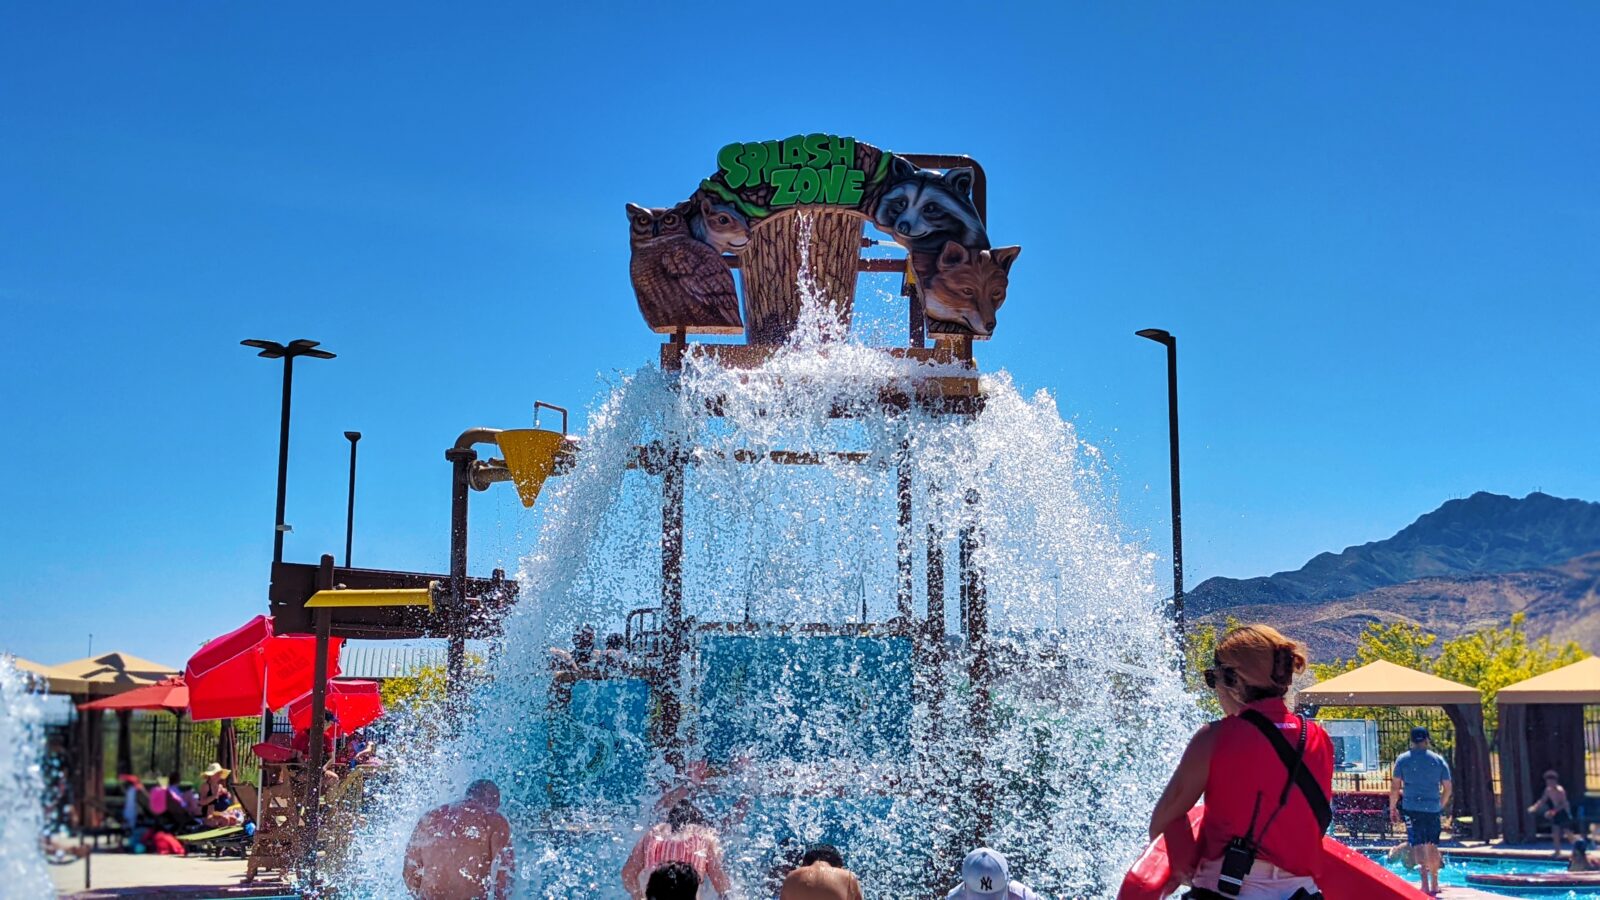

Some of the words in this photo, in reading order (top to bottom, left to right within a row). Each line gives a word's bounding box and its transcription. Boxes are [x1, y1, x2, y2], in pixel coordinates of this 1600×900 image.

[717, 132, 855, 189] SPLASH
[770, 164, 865, 205] ZONE
[980, 876, 993, 891] NY
